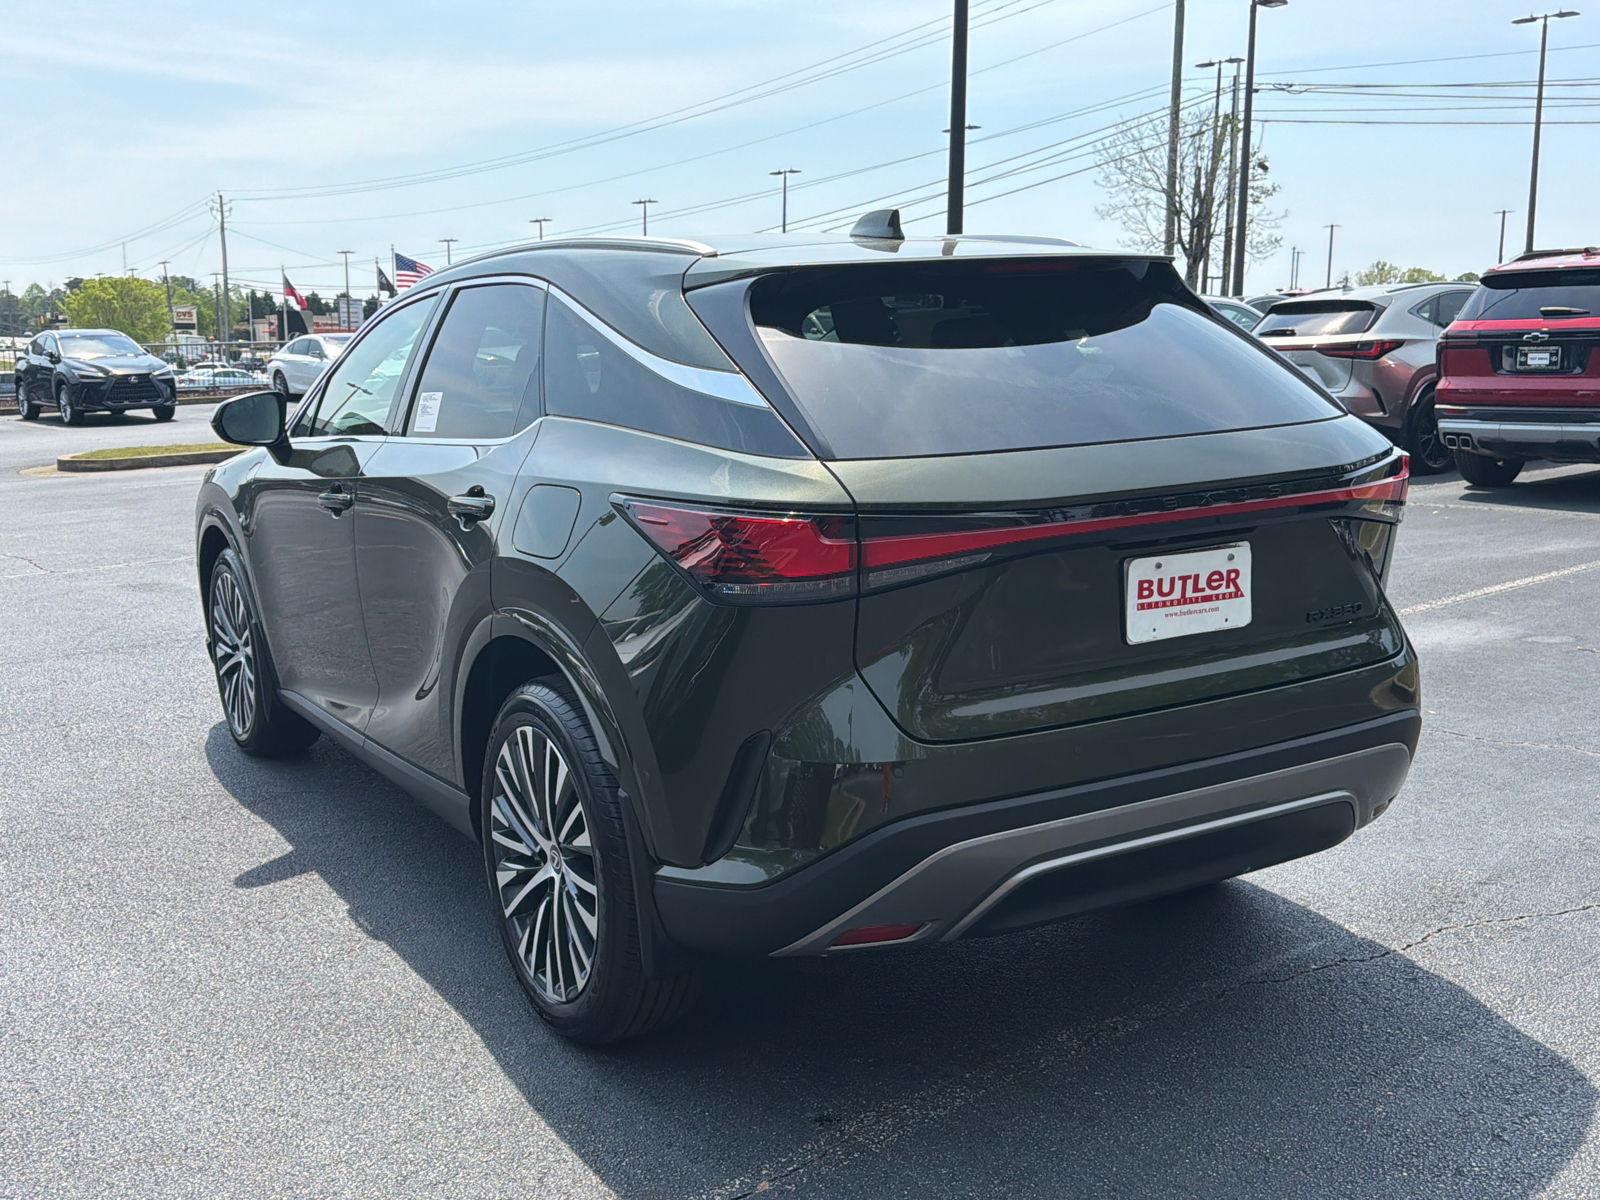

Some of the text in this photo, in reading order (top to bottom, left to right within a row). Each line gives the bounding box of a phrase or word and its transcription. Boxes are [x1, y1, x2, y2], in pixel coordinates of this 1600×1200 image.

[1122, 484, 1282, 514] LEXUS
[1137, 591, 1242, 610] AUTOMOTIVE GROUP
[1164, 606, 1220, 618] www.butlercars.com
